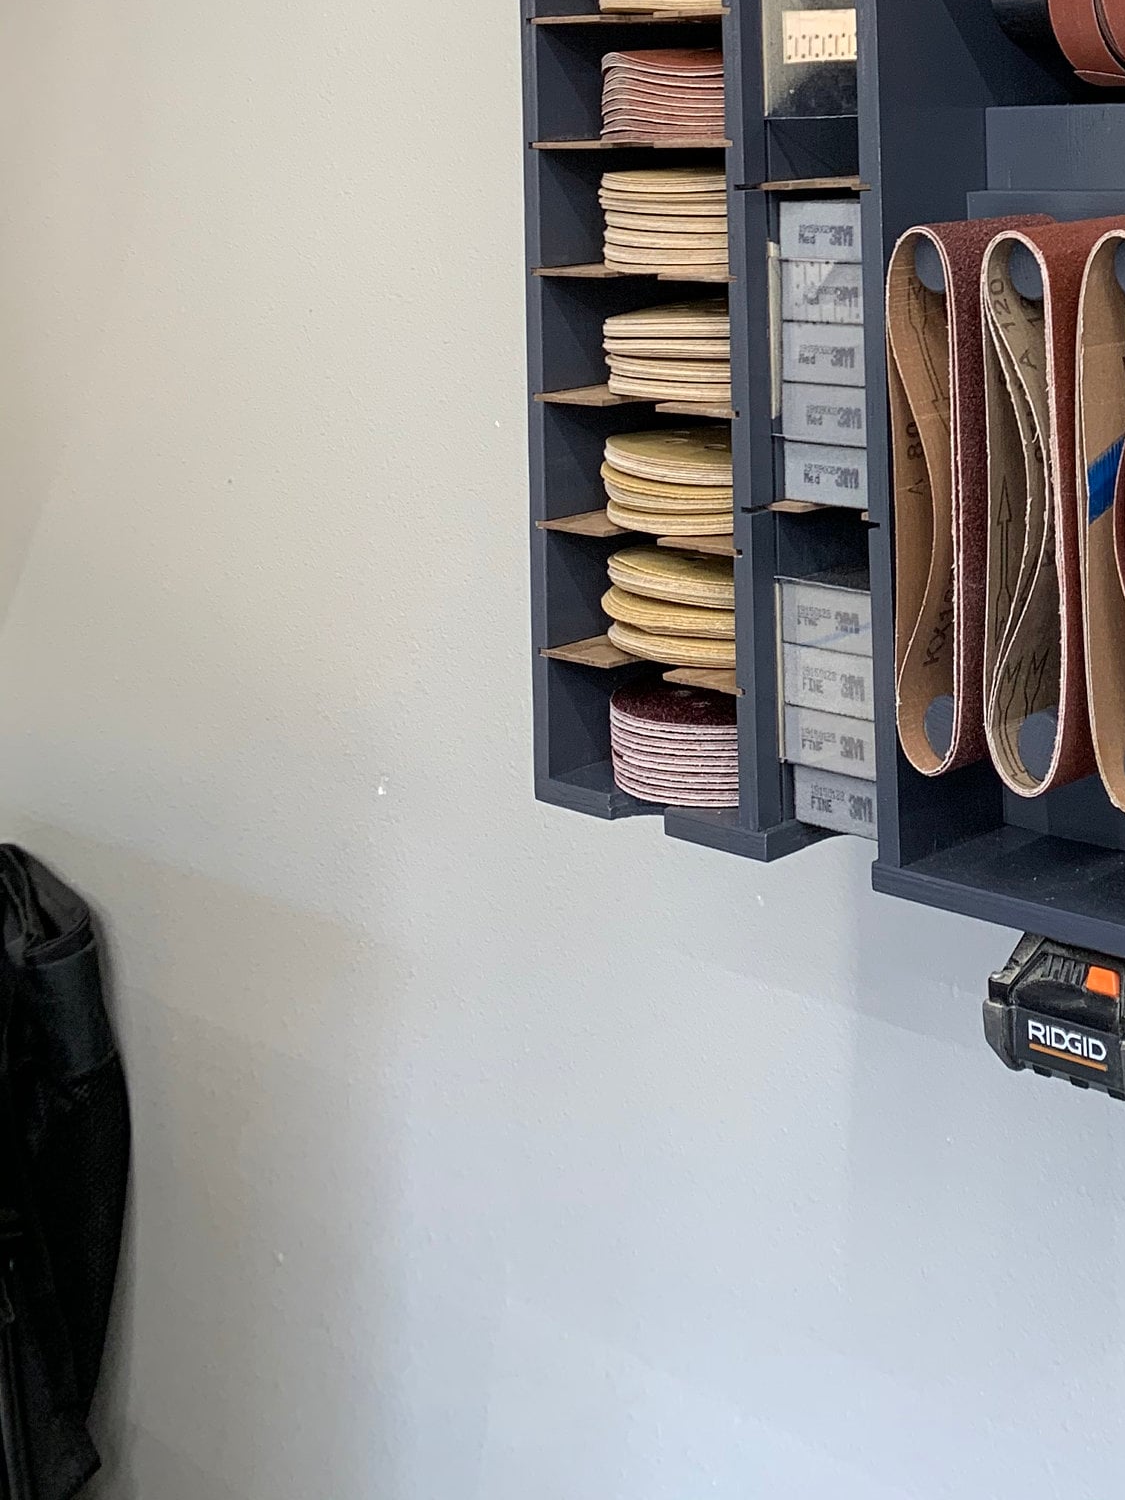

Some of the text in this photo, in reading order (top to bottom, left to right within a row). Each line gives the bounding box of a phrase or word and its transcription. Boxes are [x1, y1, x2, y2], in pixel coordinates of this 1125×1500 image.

[828, 225, 854, 247] 3M
[989, 278, 1016, 334] 120
[830, 346, 855, 369] 3M
[835, 467, 860, 490] 3M
[840, 673, 866, 702] 3M
[840, 734, 865, 762] 3M
[848, 793, 873, 823] 3M
[1027, 1019, 1108, 1062] RIDGID
